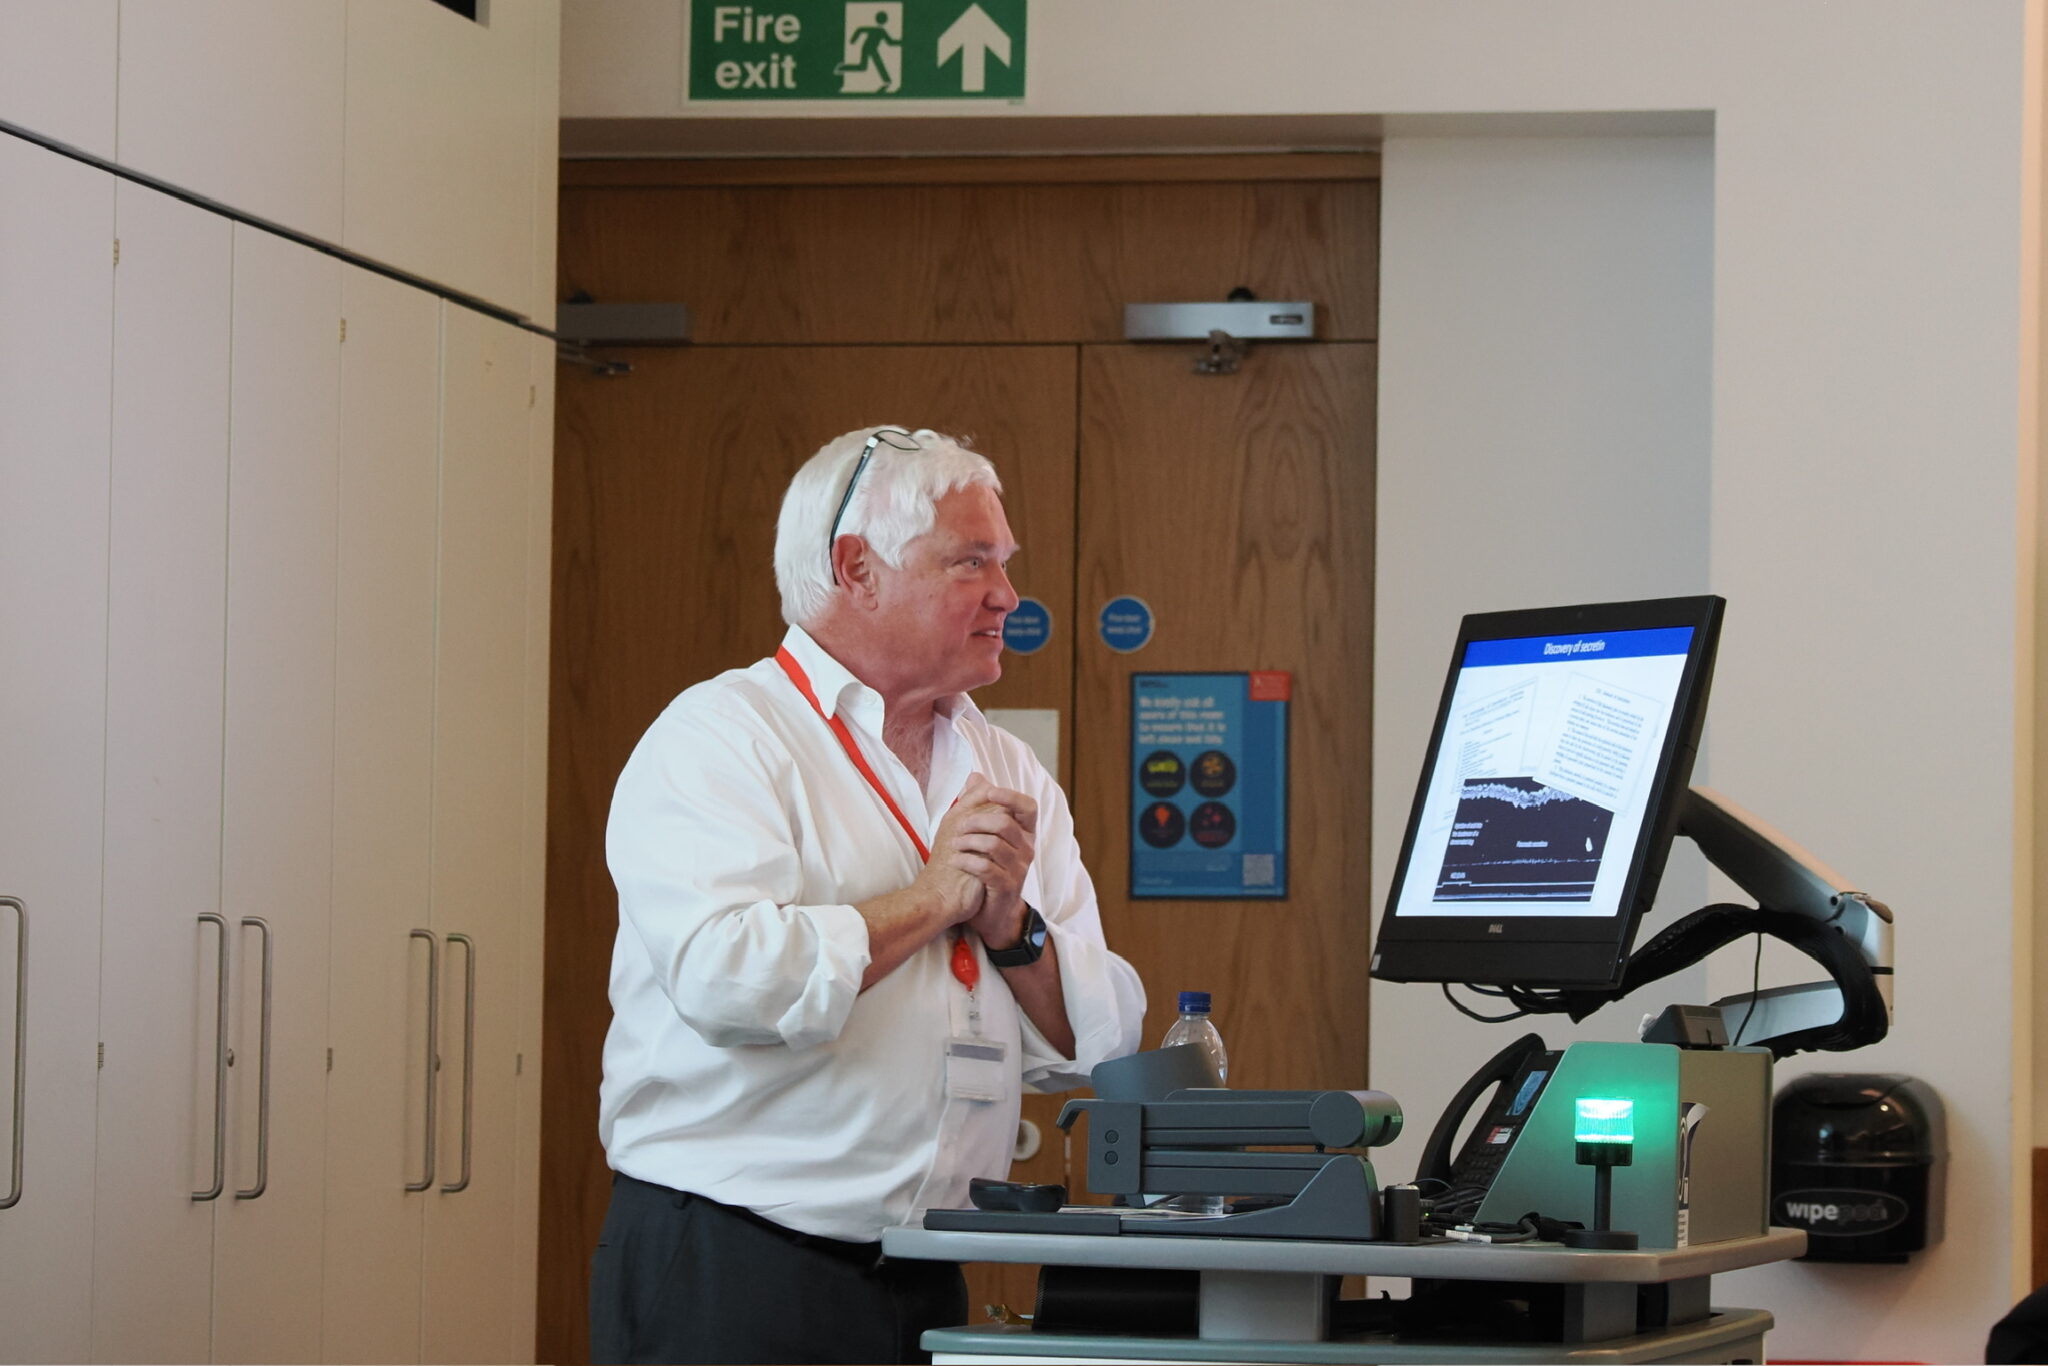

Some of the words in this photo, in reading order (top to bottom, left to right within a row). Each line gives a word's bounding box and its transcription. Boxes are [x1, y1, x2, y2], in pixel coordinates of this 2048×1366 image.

[714, 7, 800, 43] Fire
[715, 53, 796, 89] exit
[1544, 642, 1573, 656] Discovery
[1572, 640, 1582, 653] of
[1580, 640, 1605, 652] secretin
